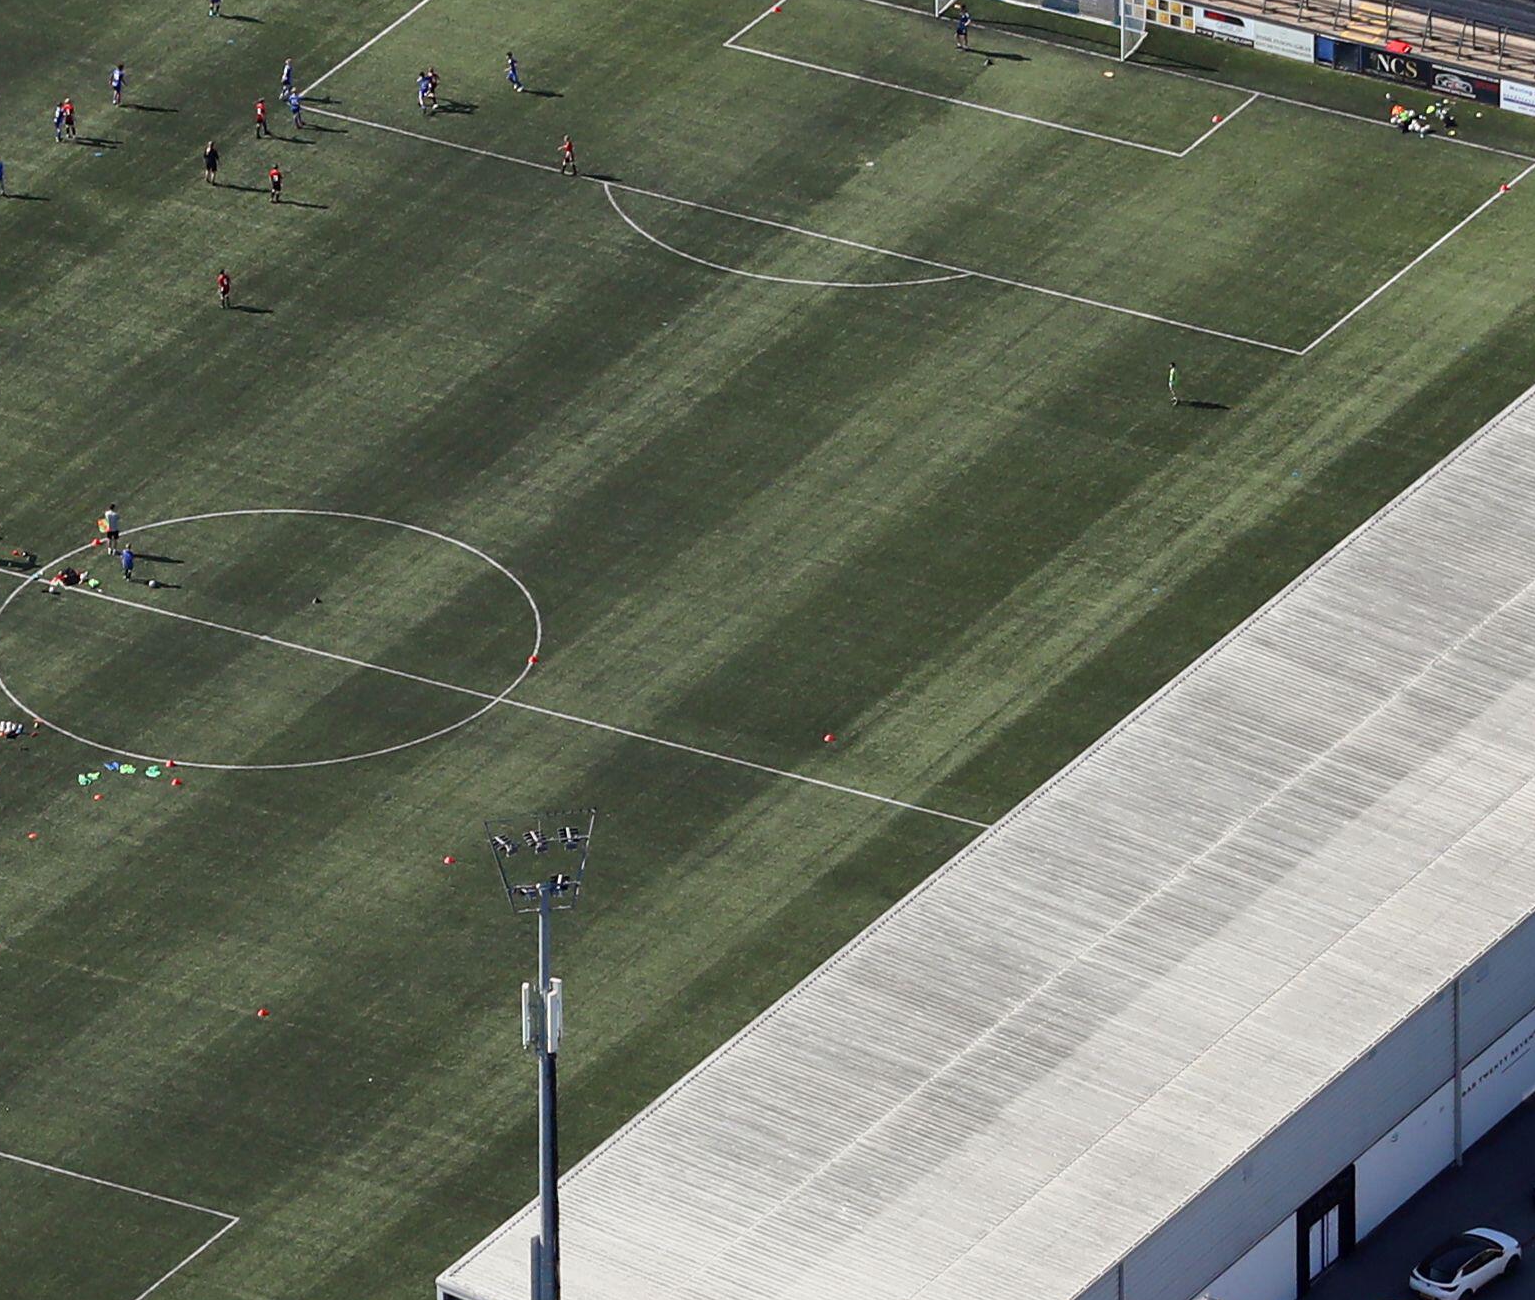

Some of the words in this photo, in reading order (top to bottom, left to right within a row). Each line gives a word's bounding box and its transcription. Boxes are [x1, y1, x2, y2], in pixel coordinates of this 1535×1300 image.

[1377, 54, 1418, 78] NCS
[1461, 1080, 1476, 1097] BAR
[1478, 1055, 1508, 1083] TWENTY
